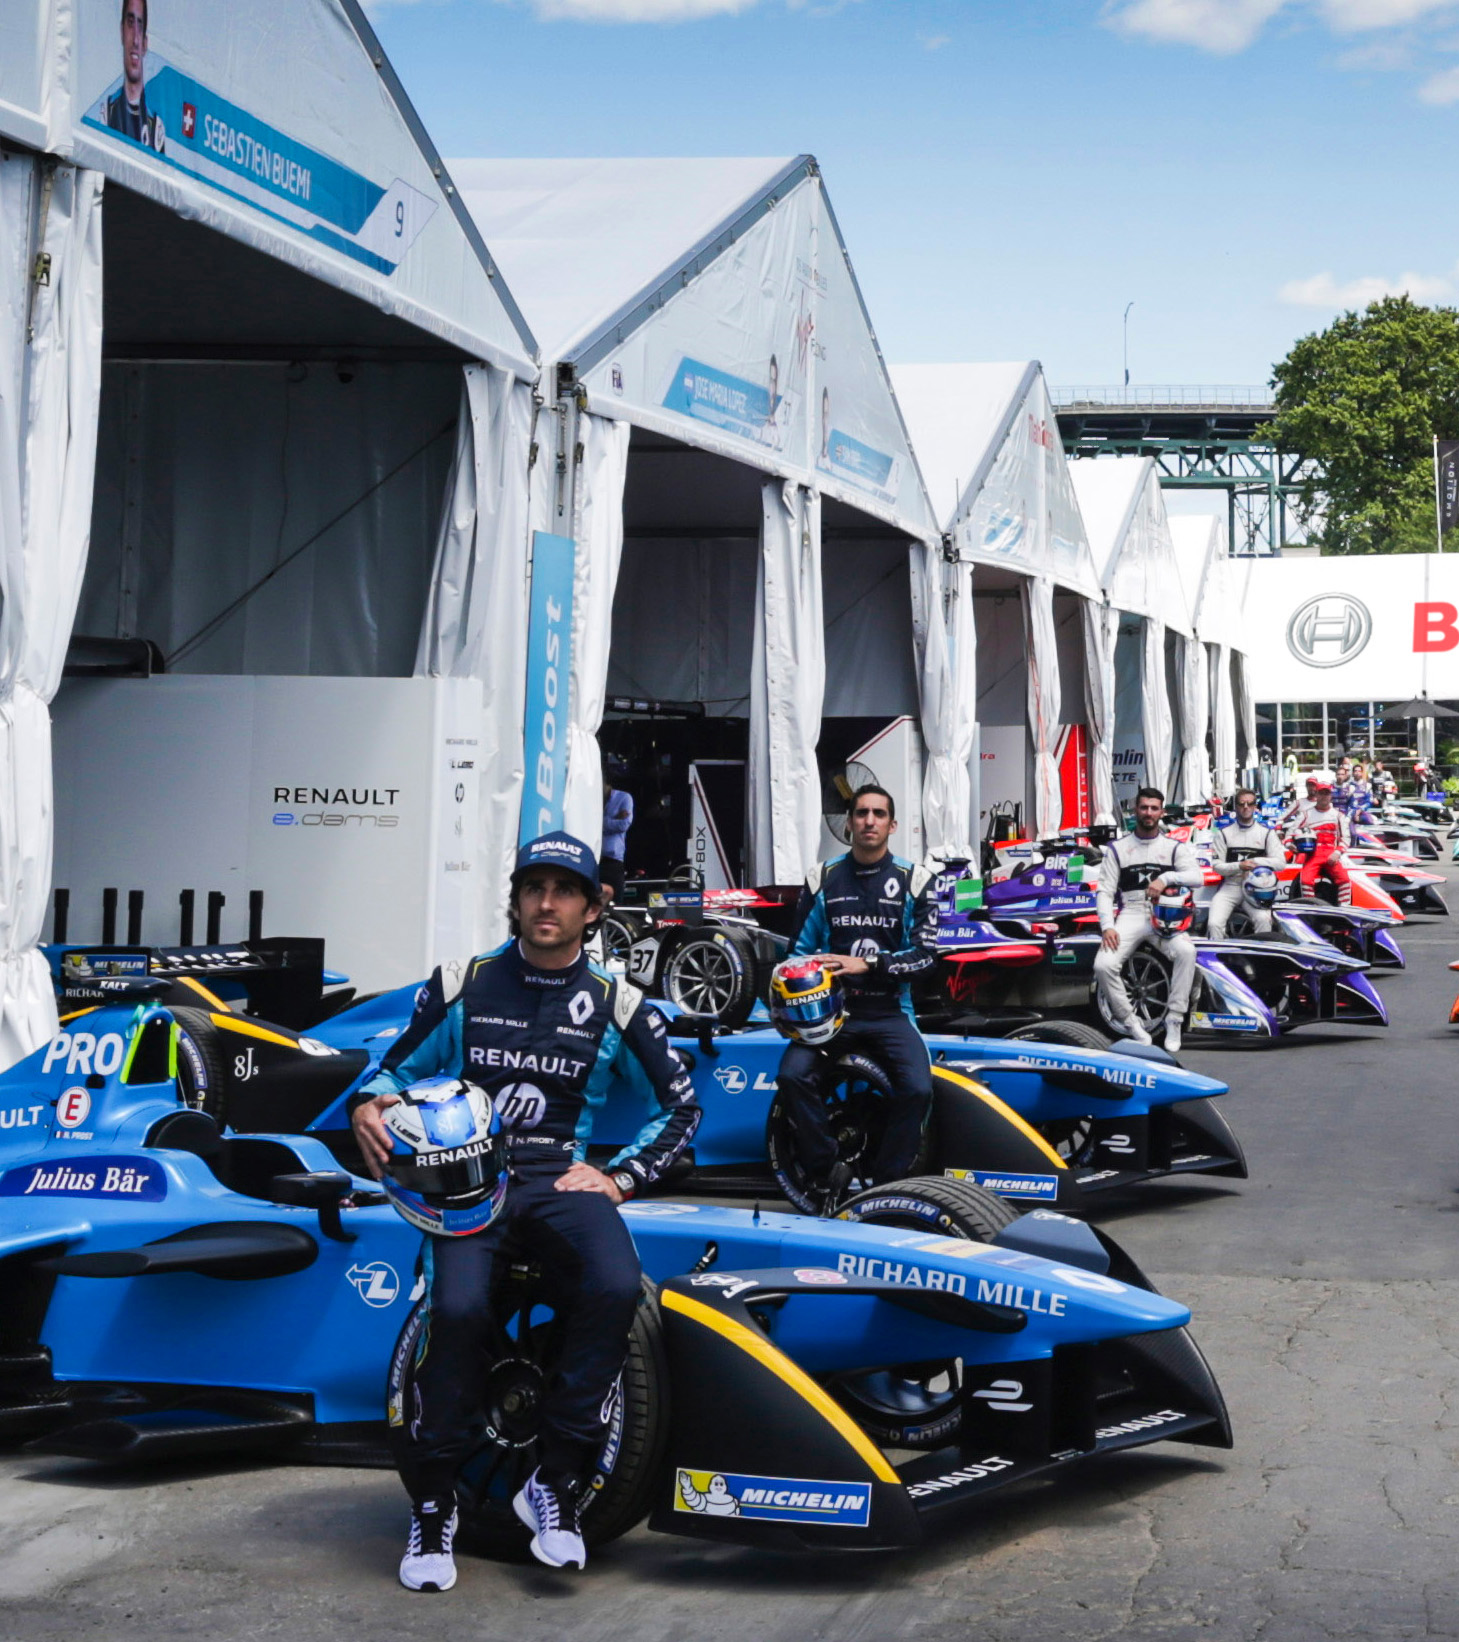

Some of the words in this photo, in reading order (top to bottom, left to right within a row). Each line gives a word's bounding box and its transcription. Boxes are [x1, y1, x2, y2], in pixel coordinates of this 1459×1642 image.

[203, 113, 272, 188] SEBASTIEN
[272, 155, 312, 201] BUEMI
[393, 200, 404, 238] 9
[535, 595, 564, 838] nBoost
[1112, 749, 1144, 766] mlin
[273, 786, 400, 806] RENAULT
[272, 810, 400, 828] e.dams
[530, 841, 583, 857] RENAULT
[934, 874, 957, 893] OP
[831, 914, 898, 929] RENAULT
[936, 927, 955, 937] lius
[956, 926, 977, 938] Bär
[94, 959, 146, 971] MIELIN
[631, 949, 655, 975] 37
[524, 975, 566, 986] RENAULT
[785, 988, 832, 1007] RENAULT
[556, 1026, 596, 1040] RENAULT
[41, 1031, 125, 1077] PRO
[469, 1046, 588, 1080] RENAULT
[1101, 1067, 1158, 1090] MILLE
[66, 1093, 83, 1122] E
[498, 1082, 545, 1130] hp
[527, 1136, 556, 1145] PROST
[415, 1138, 494, 1168] RENAULT
[24, 1166, 96, 1195] Julius
[100, 1166, 150, 1194] Bär
[983, 1178, 1055, 1192] MICHELIN
[860, 1197, 936, 1218] MICHELIN
[837, 1252, 967, 1296] RICHARD
[976, 1275, 1069, 1319] MILLE
[392, 1315, 422, 1389] MICHEL
[740, 1487, 866, 1511] MICHELIN
